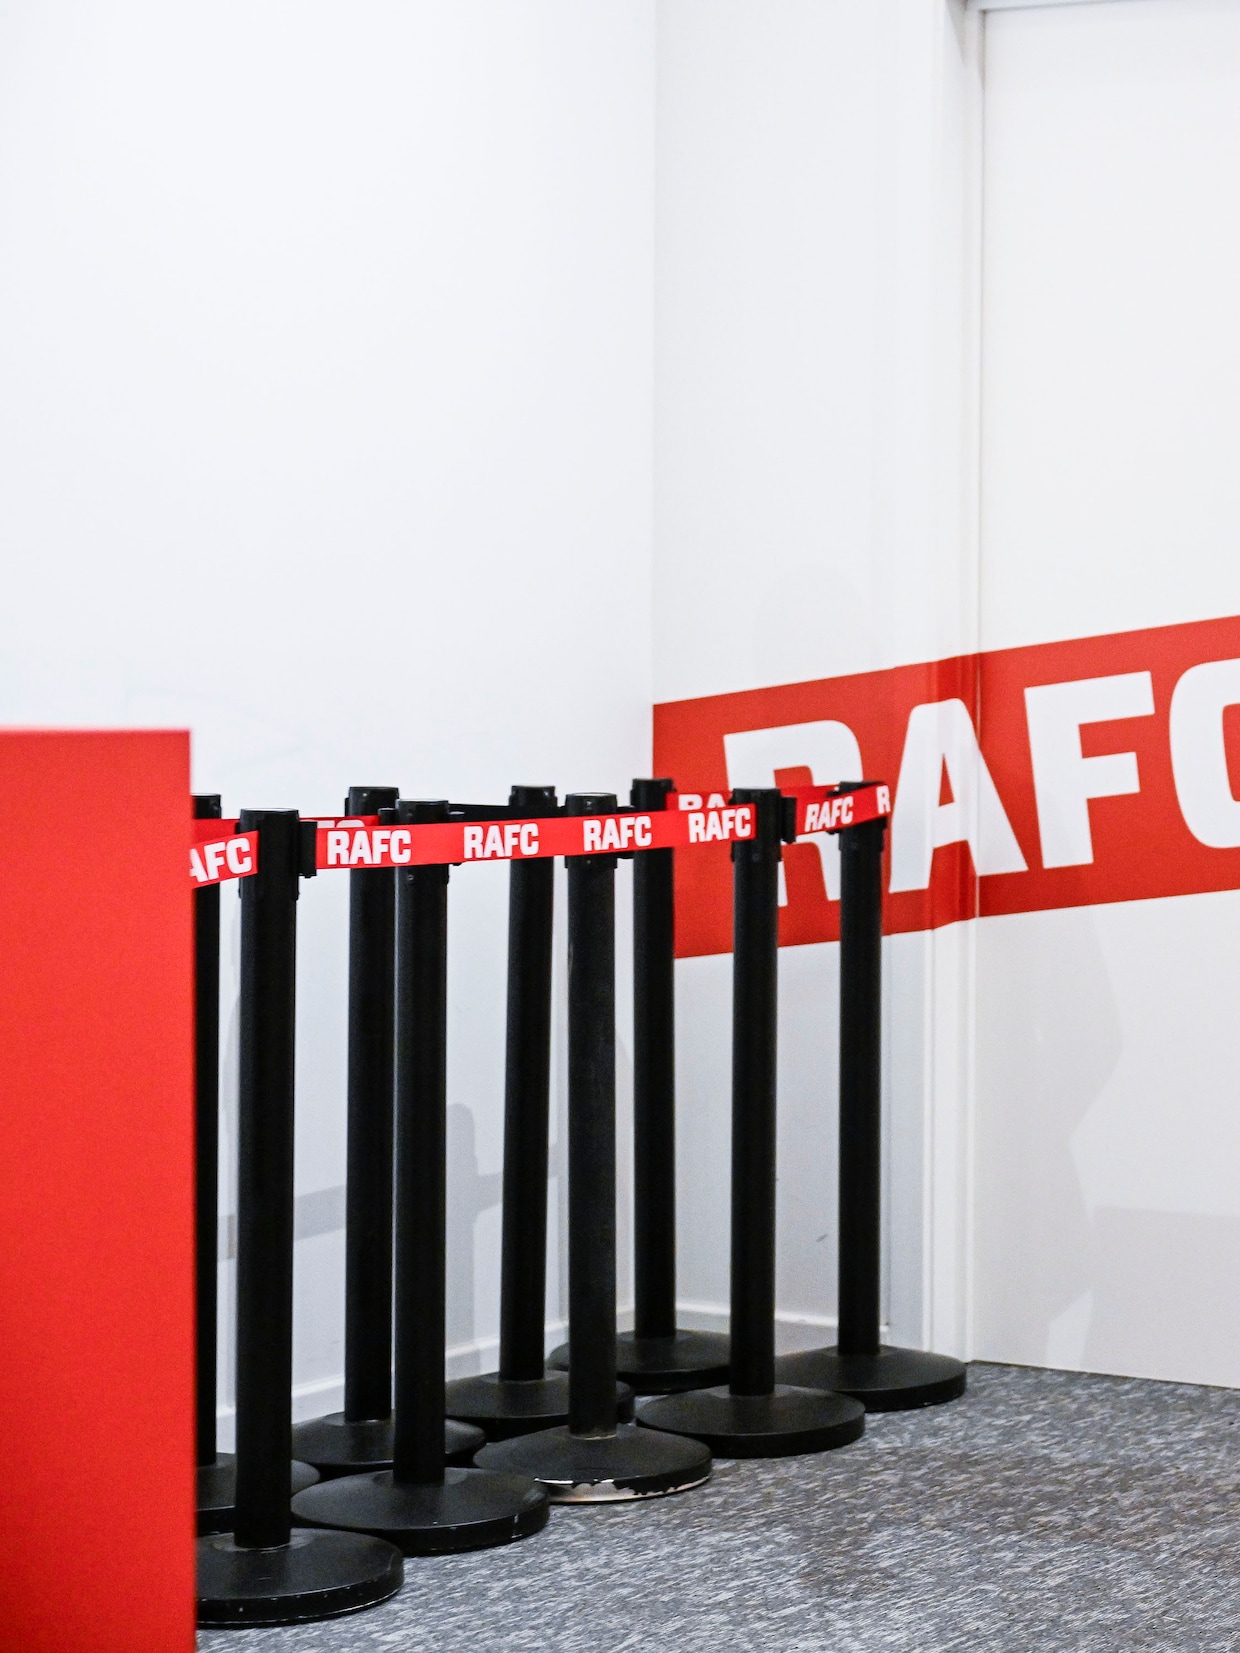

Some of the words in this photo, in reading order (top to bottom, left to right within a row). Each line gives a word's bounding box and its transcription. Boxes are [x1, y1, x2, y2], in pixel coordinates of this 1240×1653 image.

[327, 829, 411, 865] RAFC
[463, 823, 539, 859] RAFC
[583, 816, 652, 850] RAFC
[688, 807, 751, 843] RAFC
[804, 796, 854, 832] RAFC
